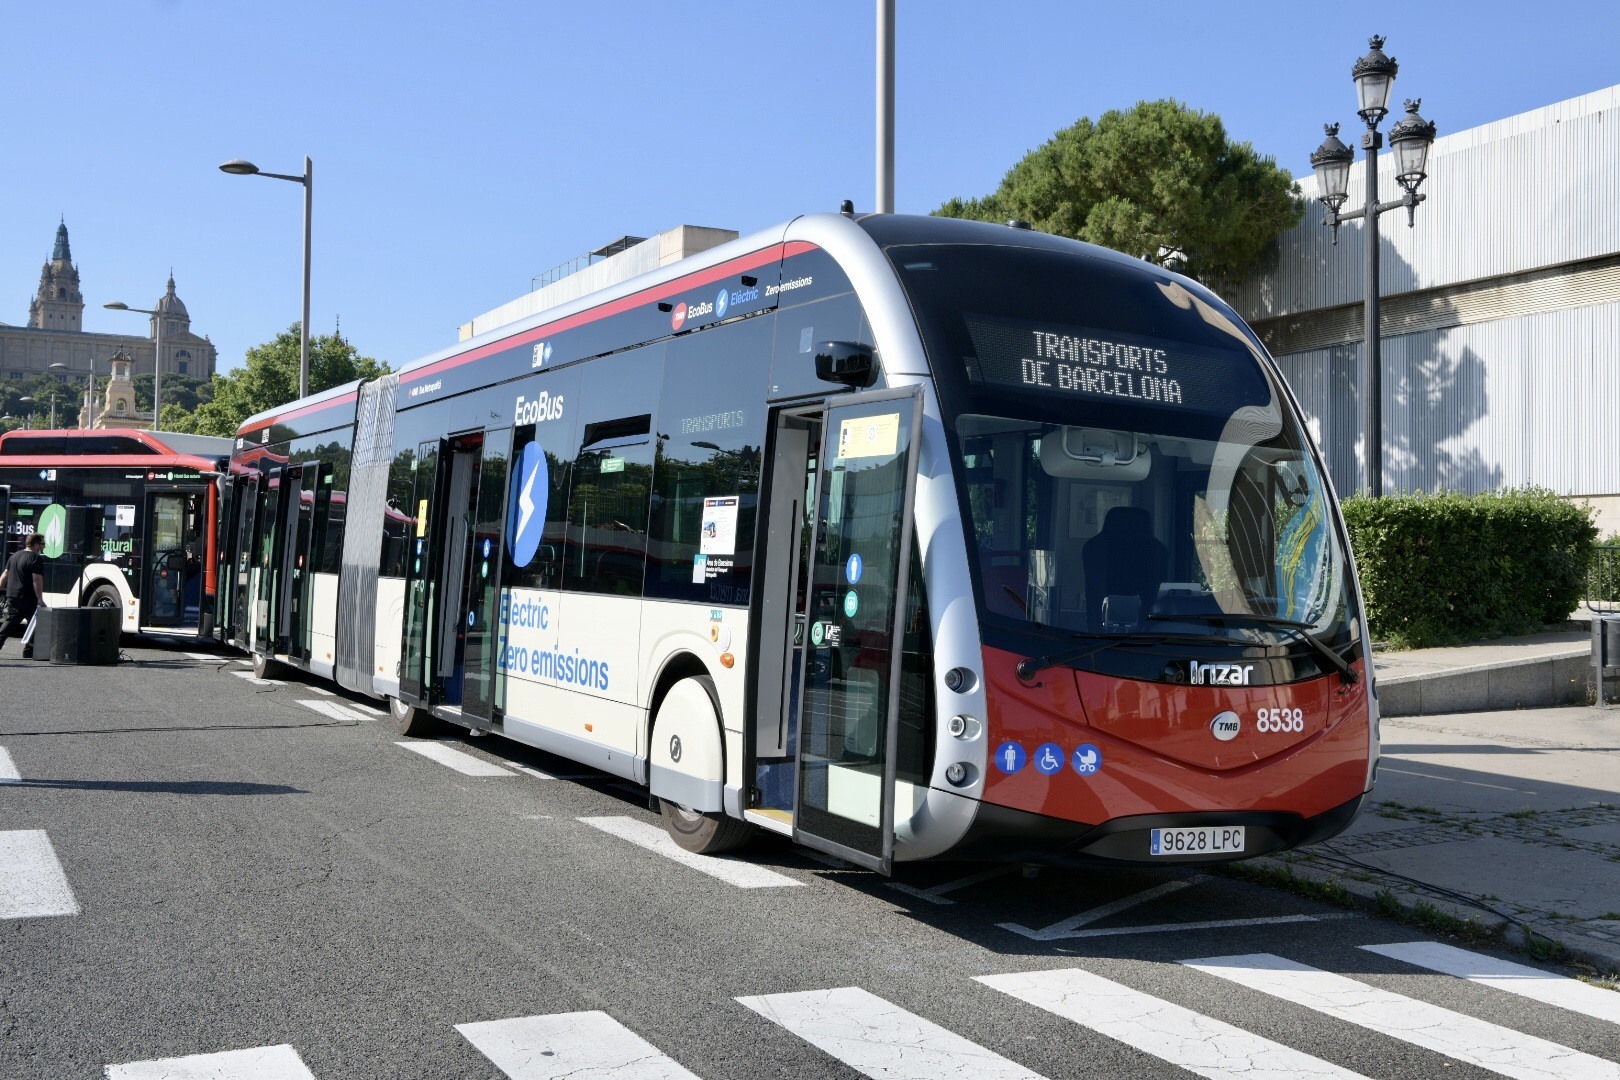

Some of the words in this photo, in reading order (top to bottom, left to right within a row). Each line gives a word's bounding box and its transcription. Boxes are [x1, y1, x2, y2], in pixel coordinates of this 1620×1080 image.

[688, 302, 713, 319] EcoBus
[731, 287, 759, 306] Elèctric
[765, 285, 779, 297] Zero
[780, 276, 813, 292] emissions
[1033, 331, 1168, 374] TRANSPORTS
[1021, 358, 1052, 387] DE
[1058, 363, 1182, 404] BARCELONA
[515, 390, 564, 426] EcoBus
[680, 410, 744, 434] TRANSPORTS
[101, 538, 133, 553] atural
[500, 592, 549, 630] Elèctric
[498, 636, 528, 673] Zero
[531, 644, 609, 691] emissions
[1190, 660, 1254, 686] Irizar
[1218, 722, 1238, 731] TMB
[1256, 708, 1304, 733] 8538
[1163, 830, 1207, 850] 9628
[1212, 829, 1241, 849] LPC
